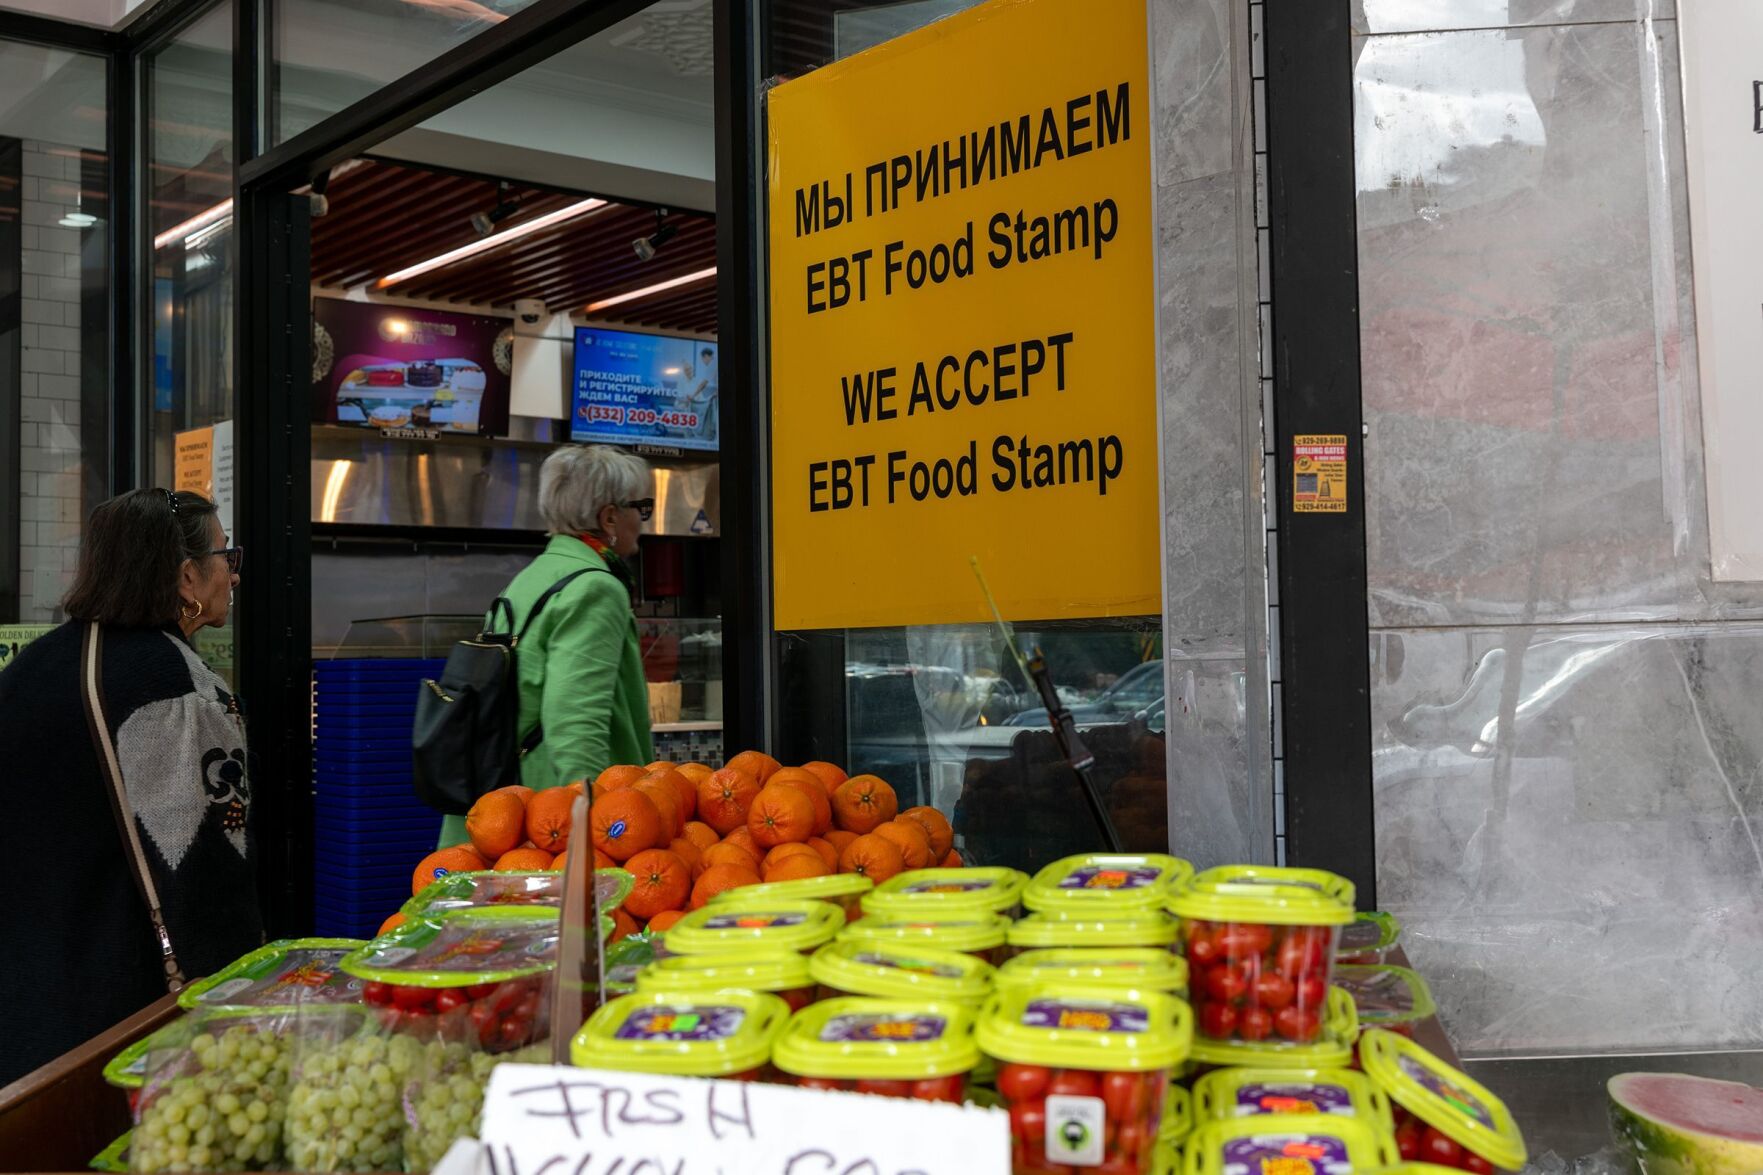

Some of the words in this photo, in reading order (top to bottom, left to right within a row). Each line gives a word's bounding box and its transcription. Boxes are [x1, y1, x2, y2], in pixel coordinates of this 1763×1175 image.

[795, 172, 853, 238] МЫ
[865, 81, 1131, 218] ПРИНИМАЕМ
[806, 248, 873, 315] EBT
[884, 220, 974, 296] Food
[987, 198, 1119, 270] Stamp
[579, 391, 611, 401] ЖДЕМ
[614, 395, 638, 403] ВАС!
[580, 370, 641, 383] ПРИХОДИТЕ
[580, 381, 586, 389] И
[840, 366, 898, 427] WE
[907, 331, 1074, 417] ACCEPT
[588, 404, 625, 425] (332)
[627, 408, 698, 427] 209-4838
[809, 454, 876, 513] EBT
[887, 440, 978, 504] Food
[991, 434, 1124, 496] Stamp
